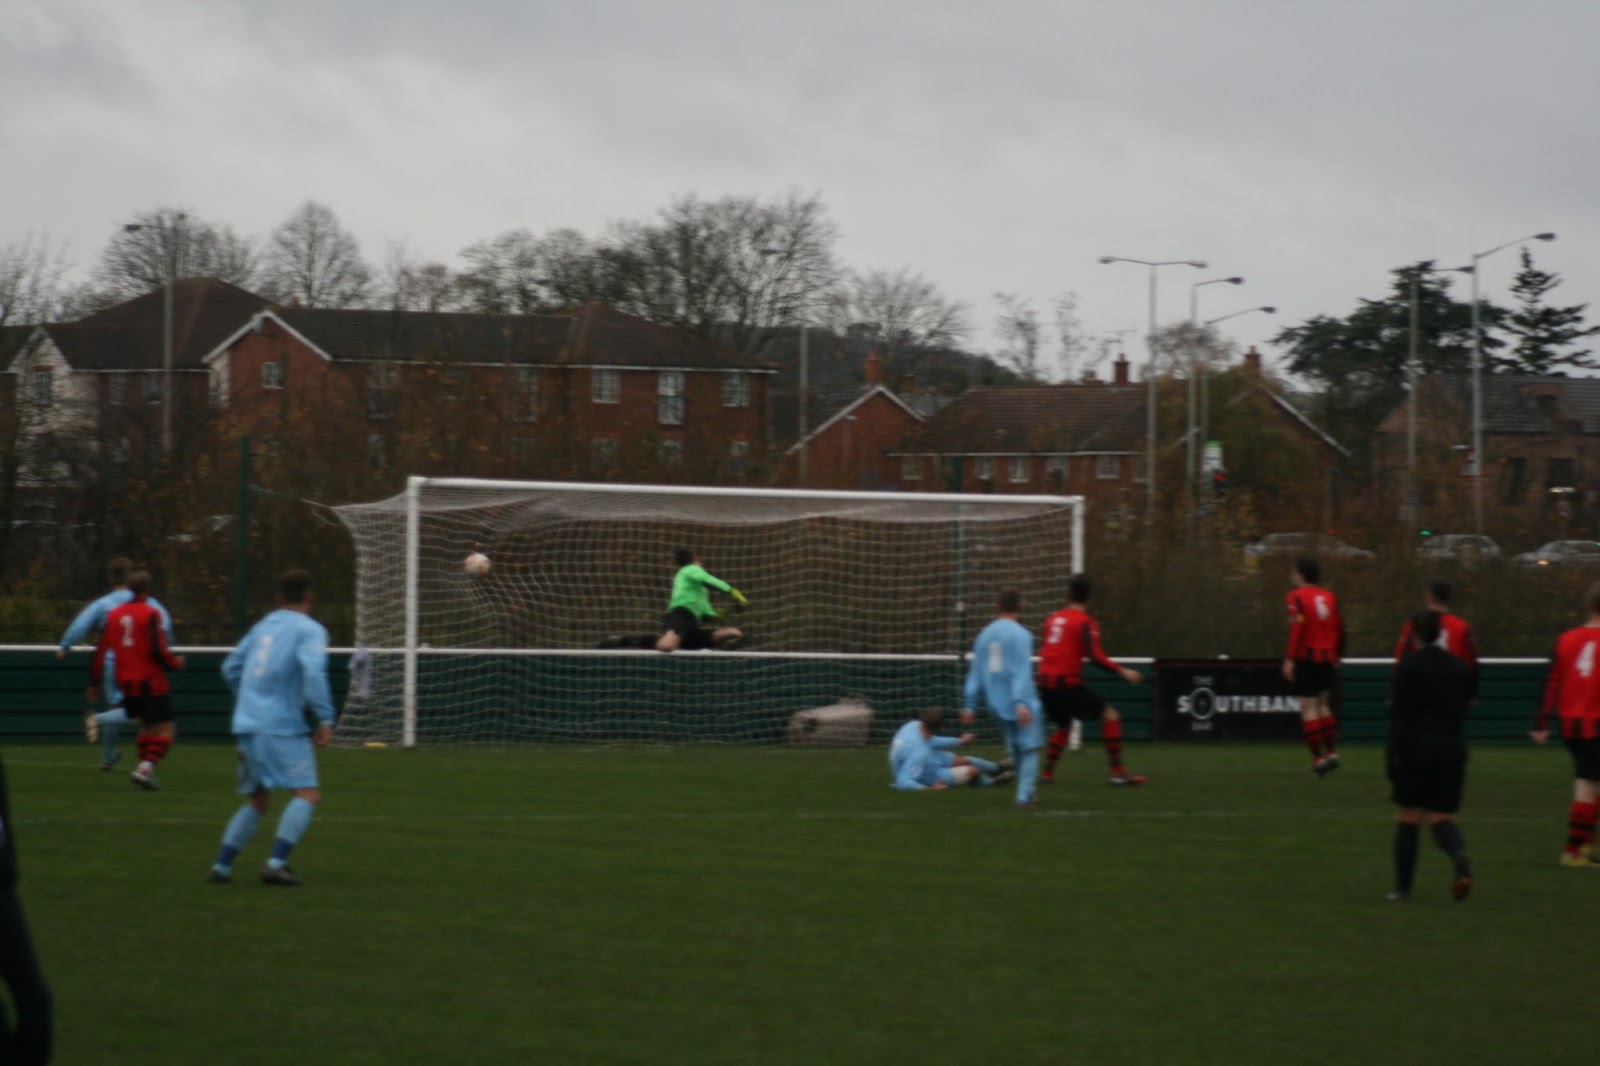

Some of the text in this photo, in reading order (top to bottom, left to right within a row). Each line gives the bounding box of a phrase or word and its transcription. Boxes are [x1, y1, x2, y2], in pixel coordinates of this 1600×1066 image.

[120, 615, 134, 646] 2
[1575, 641, 1596, 677] 4
[1176, 687, 1301, 719] SOUTHBAN
